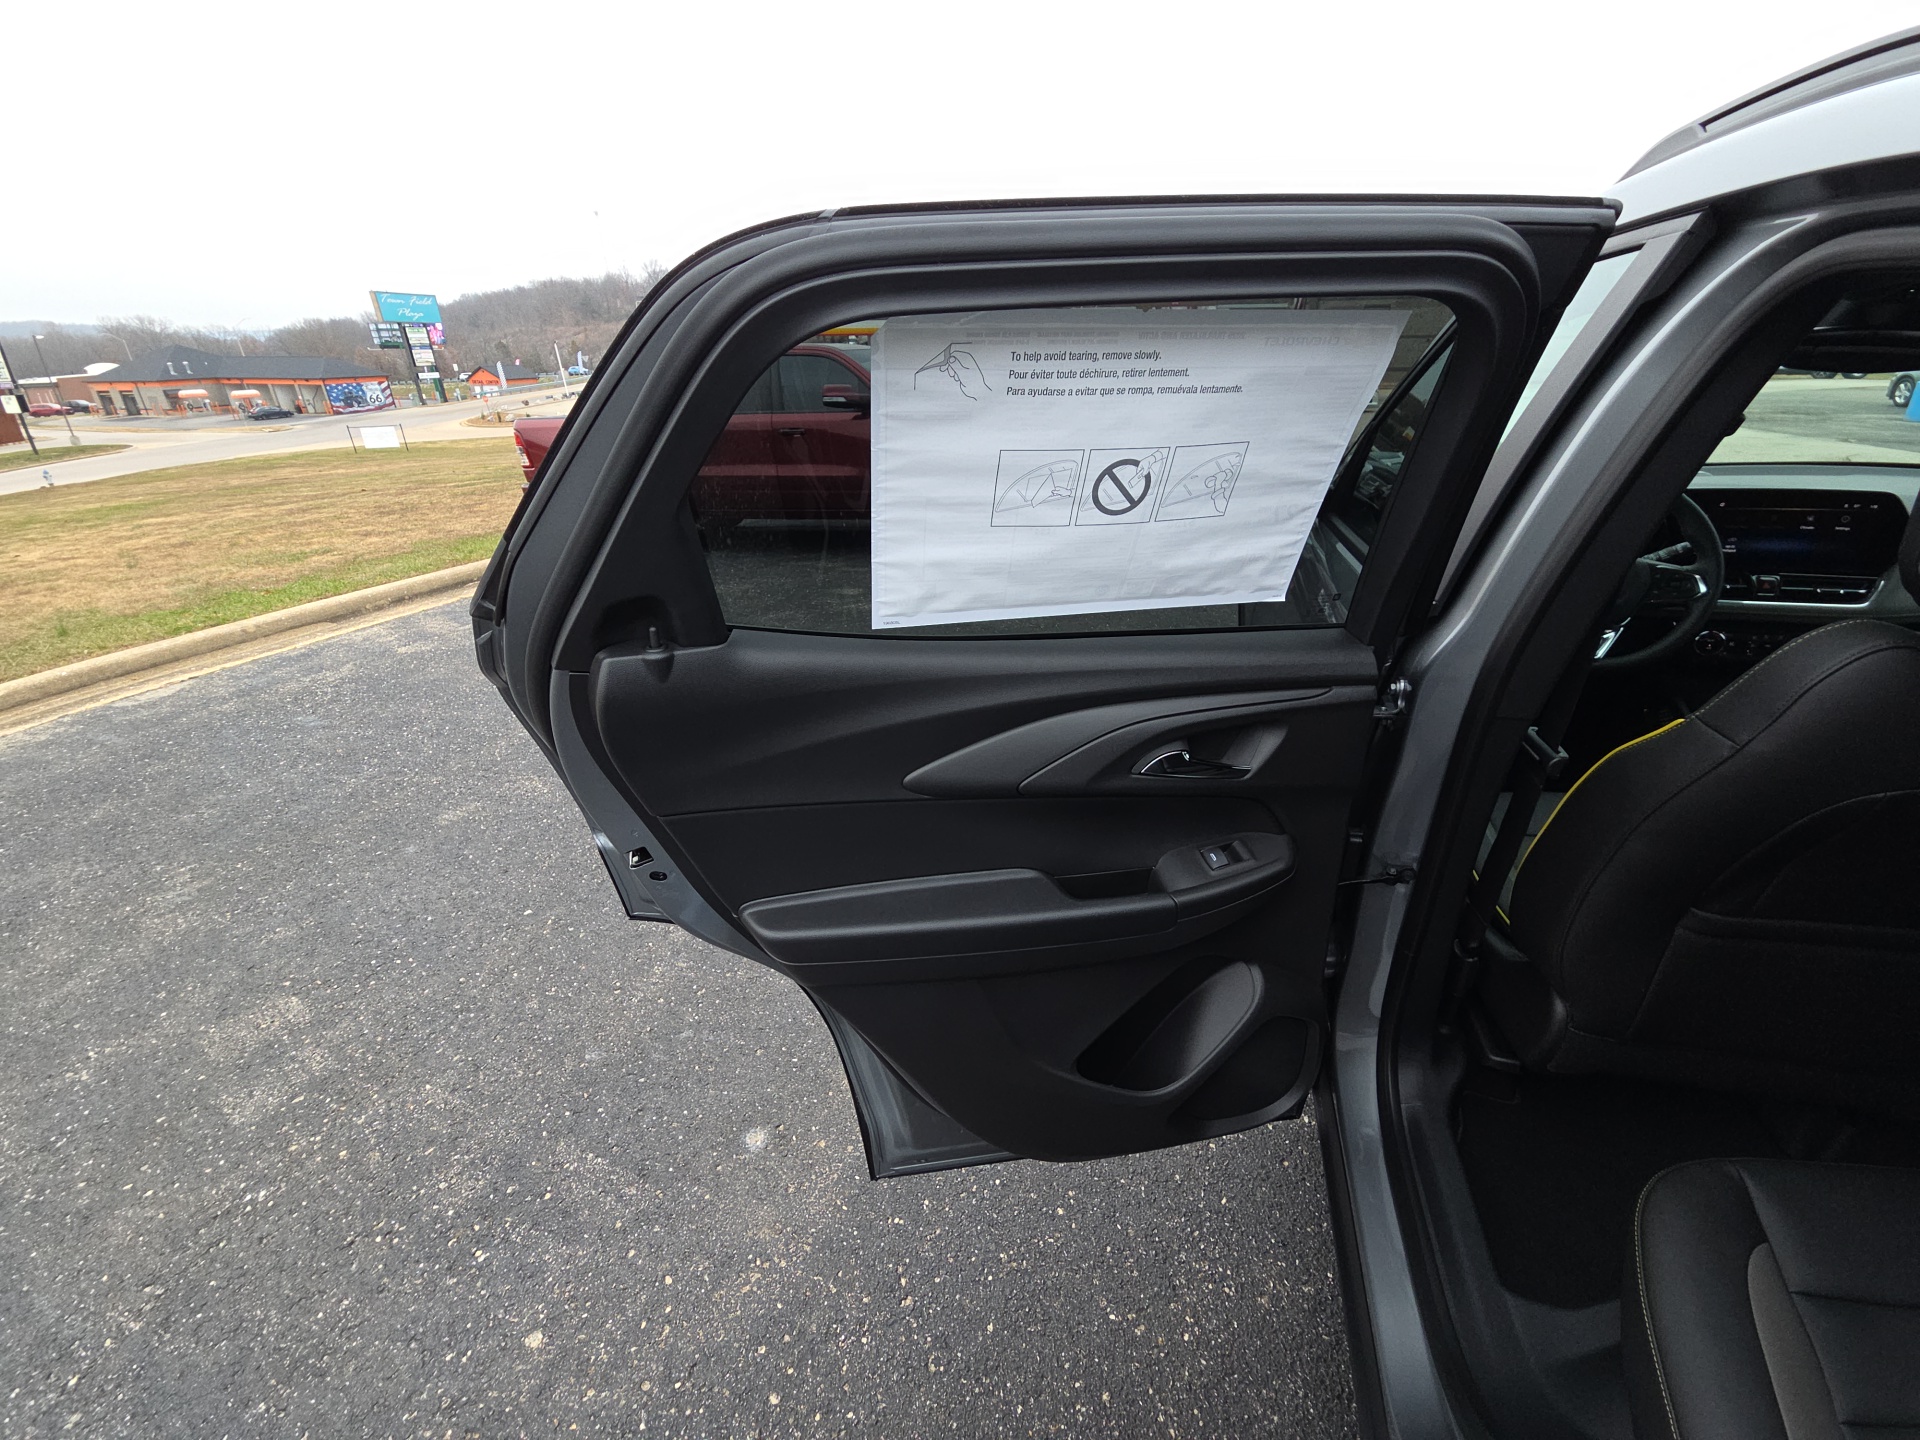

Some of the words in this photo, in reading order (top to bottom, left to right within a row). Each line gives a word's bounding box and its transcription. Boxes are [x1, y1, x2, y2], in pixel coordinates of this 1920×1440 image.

[409, 295, 433, 306] Field
[397, 307, 424, 321] Plaza
[1011, 351, 1021, 361] To
[1023, 350, 1042, 363] help
[1044, 350, 1067, 361] avoid
[1069, 350, 1099, 362] tearing,
[1101, 351, 1132, 360] remove
[1134, 349, 1162, 361] slowly.
[1009, 369, 1028, 379] Pour
[1030, 368, 1054, 379] éviter
[1056, 369, 1077, 379] toute
[1079, 367, 1119, 379] déchirure,
[1121, 367, 1147, 377] retirer
[1148, 367, 1190, 377] lentement.
[1006, 386, 1026, 396] Para
[1027, 386, 1066, 397] ayudarse
[1067, 388, 1073, 396] a
[1075, 386, 1098, 396] evitar
[1100, 388, 1115, 397] que
[1116, 387, 1126, 395] se
[1127, 386, 1154, 396] rompa,
[1156, 384, 1198, 395] remuévala
[1199, 384, 1243, 394] lentamente.
[369, 393, 383, 404] 66
